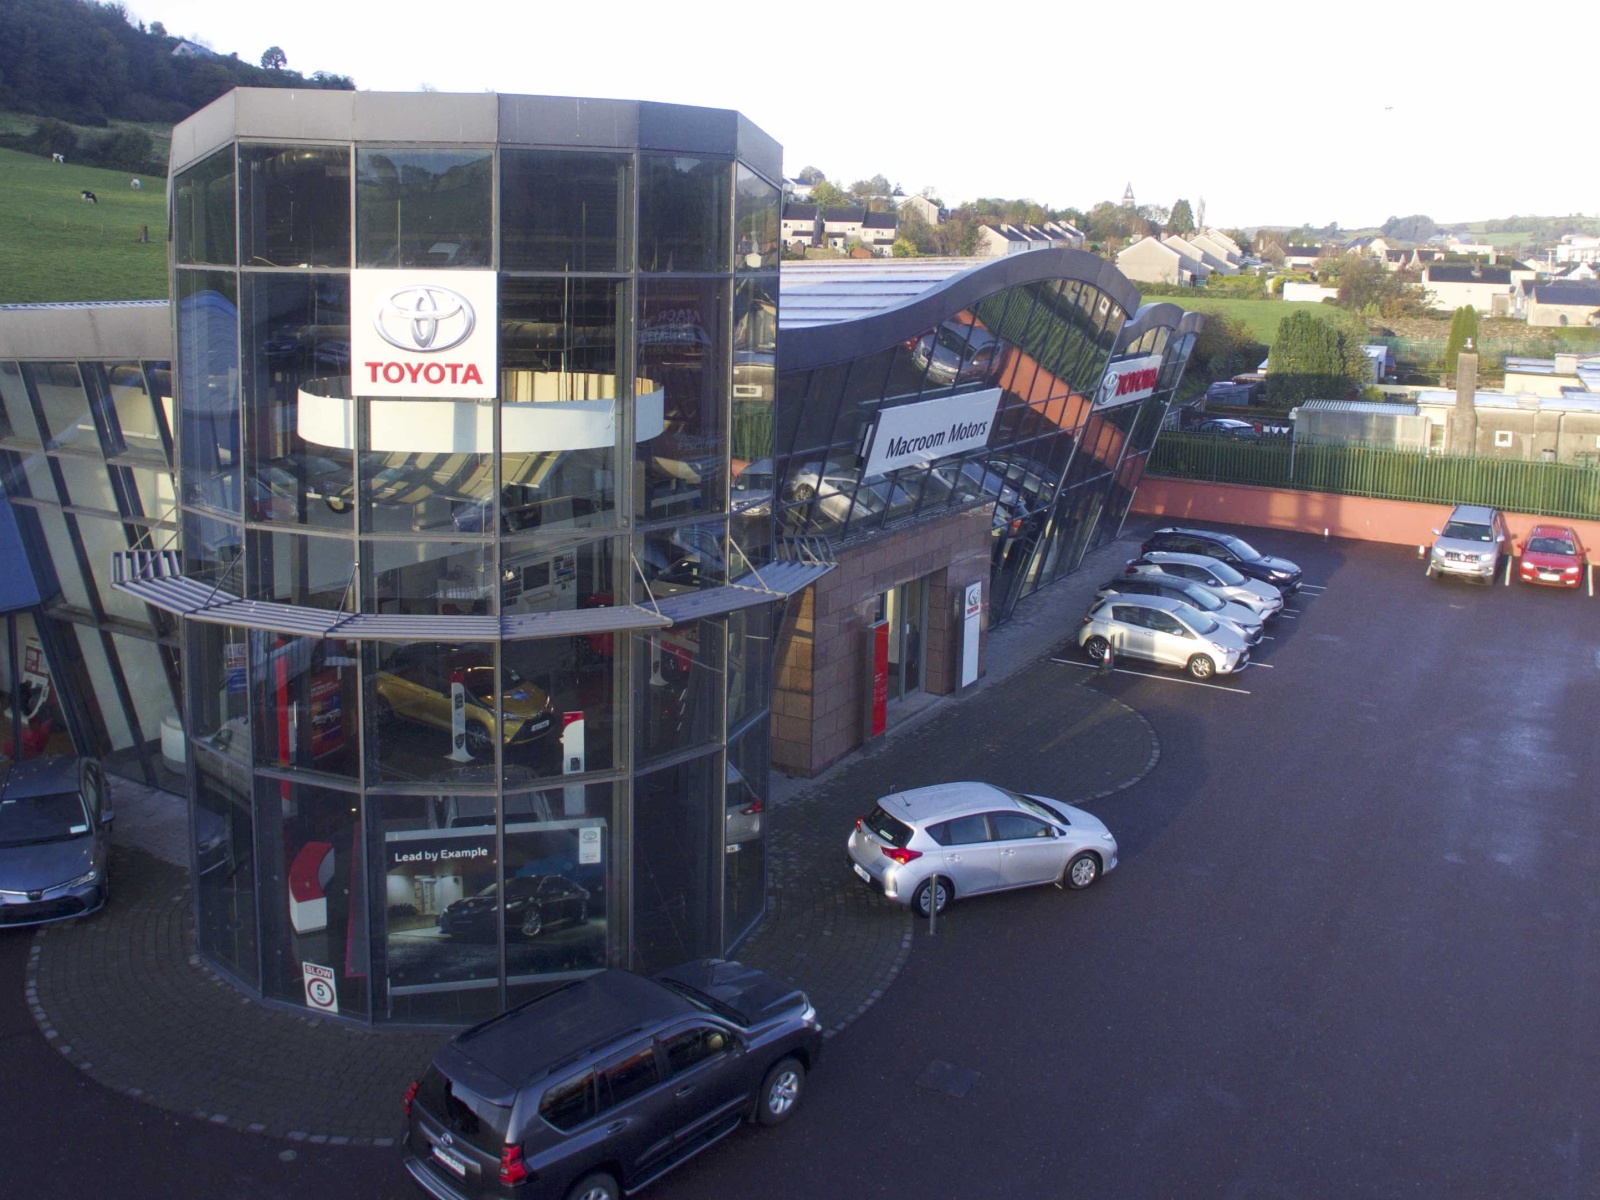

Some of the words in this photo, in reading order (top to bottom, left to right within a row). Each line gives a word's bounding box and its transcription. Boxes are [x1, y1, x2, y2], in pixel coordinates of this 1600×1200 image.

[364, 362, 483, 385] TOYOTA
[885, 431, 946, 459] Macroom
[947, 421, 988, 443] Motors
[394, 851, 422, 863] Lead
[424, 850, 439, 862] by
[440, 847, 488, 859] Example
[305, 964, 333, 979] SLOW
[316, 983, 326, 997] 5
